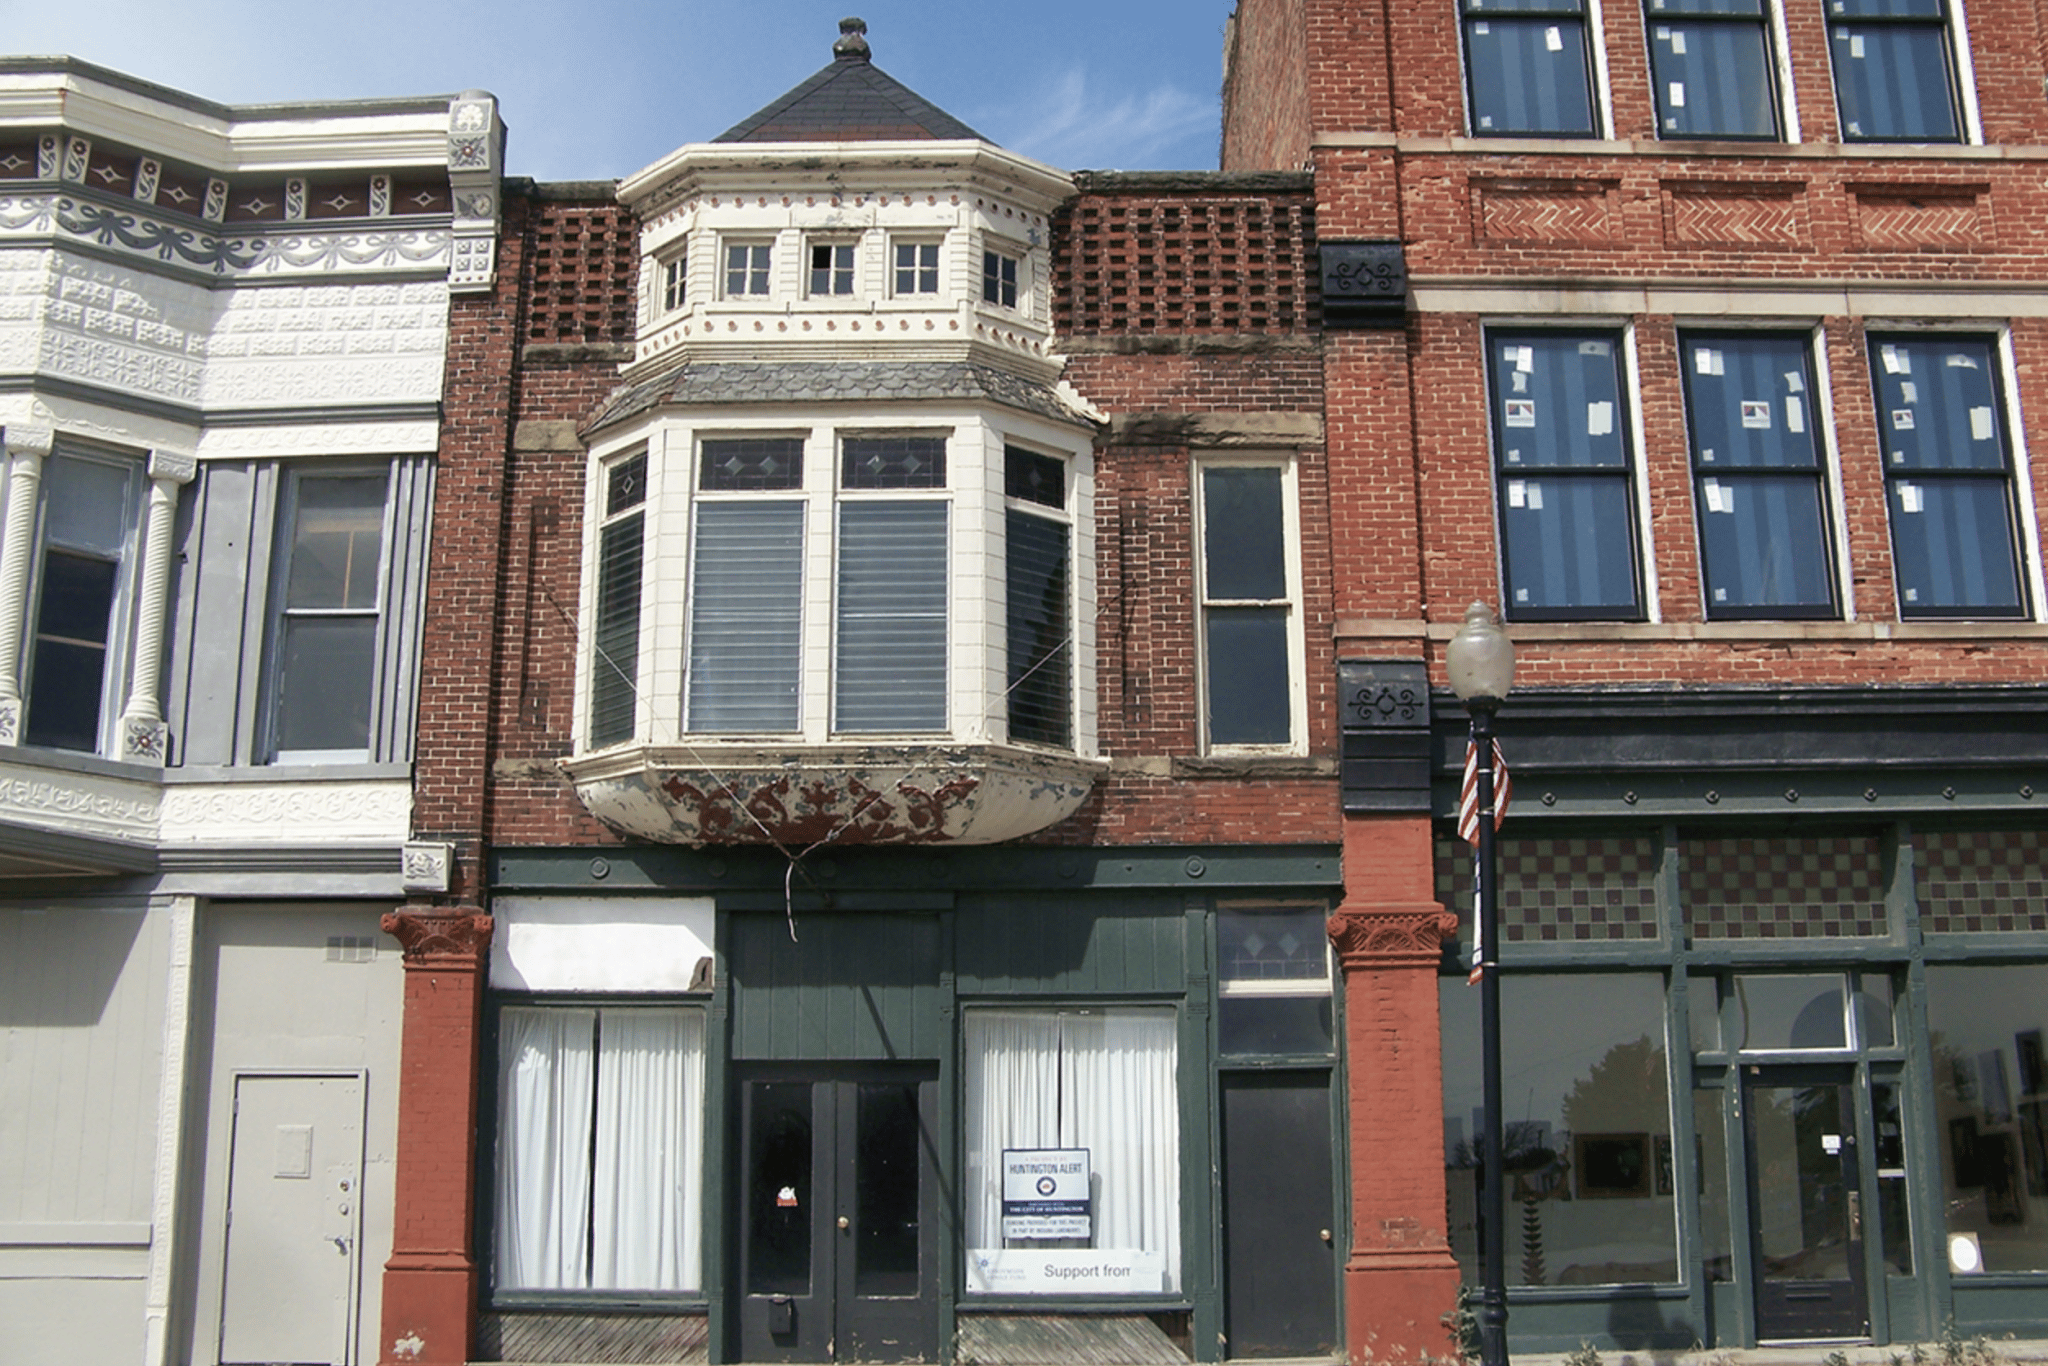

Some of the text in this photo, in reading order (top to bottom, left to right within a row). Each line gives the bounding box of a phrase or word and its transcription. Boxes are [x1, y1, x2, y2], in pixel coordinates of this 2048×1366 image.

[1010, 1163, 1082, 1174] HUNTINGTON ALERT
[1044, 1264, 1099, 1280] Support
